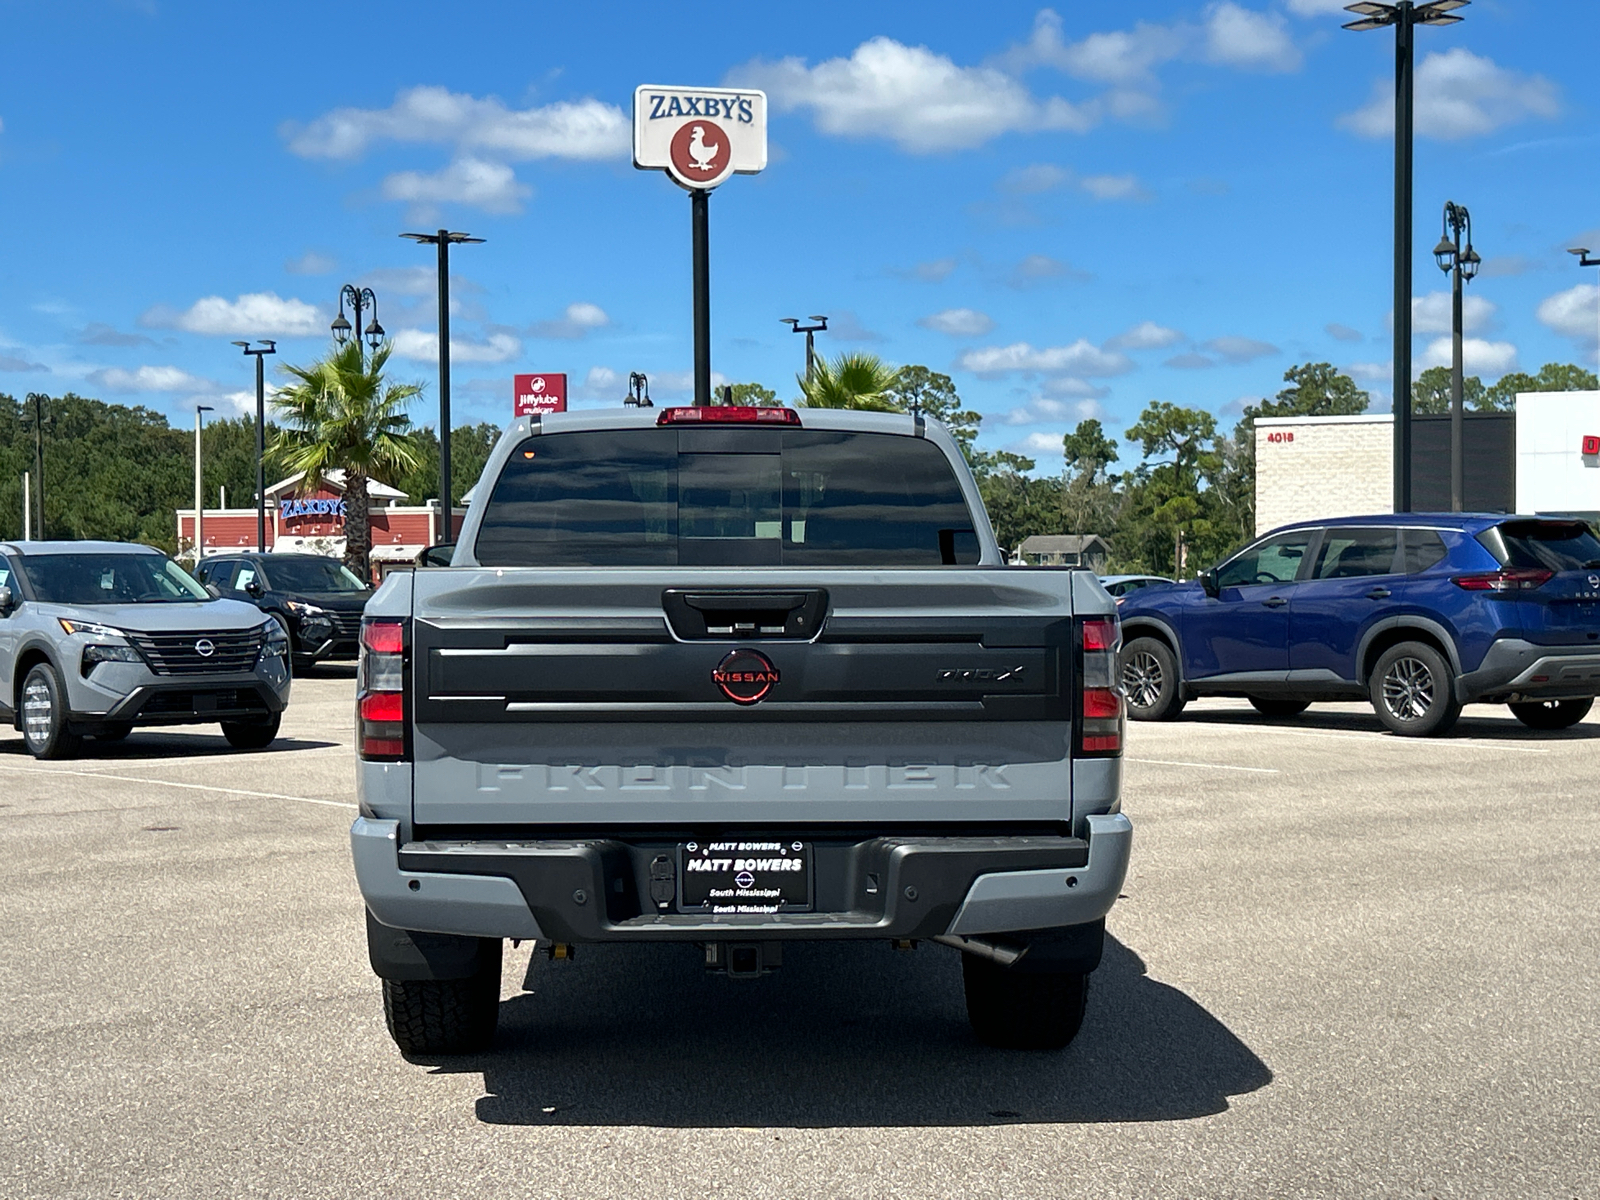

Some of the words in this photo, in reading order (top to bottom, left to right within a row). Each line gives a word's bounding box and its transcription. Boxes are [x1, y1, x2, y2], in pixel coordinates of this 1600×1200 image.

[649, 95, 753, 124] ZAXBY'S
[714, 672, 779, 682] NISSAN
[476, 756, 1012, 791] FRONTIER
[709, 842, 737, 851] MATT
[738, 842, 782, 851] BOWERS
[687, 858, 733, 871] MATT
[733, 858, 803, 871] BOWERS
[709, 889, 734, 897] South
[735, 888, 781, 897] Mississippi
[713, 905, 736, 913] South
